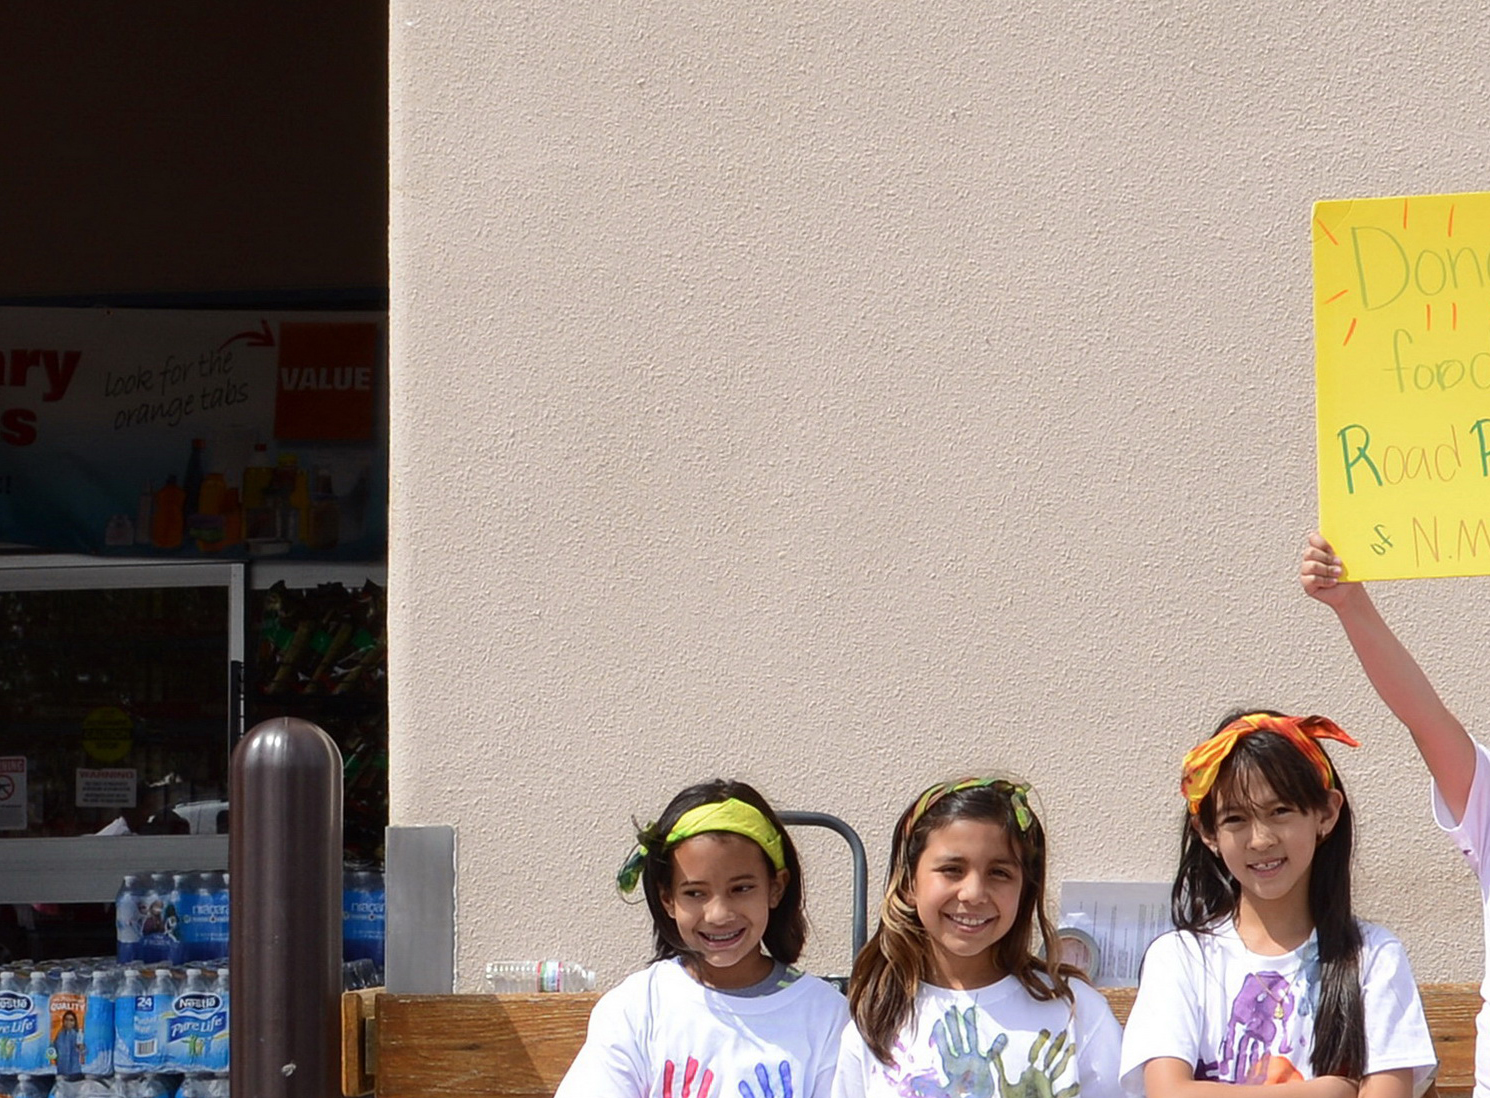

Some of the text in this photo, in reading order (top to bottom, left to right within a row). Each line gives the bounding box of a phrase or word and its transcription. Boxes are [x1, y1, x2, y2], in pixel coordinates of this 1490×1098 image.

[160, 355, 192, 396] for
[198, 350, 235, 379] the
[280, 366, 372, 391] VALUE
[114, 377, 250, 431] orange tabs
[1337, 423, 1462, 495] Road
[51, 1002, 85, 1012] QUALITY
[137, 996, 153, 1008] 24
[171, 1021, 200, 1038] Pure
[200, 1014, 223, 1033] Life
